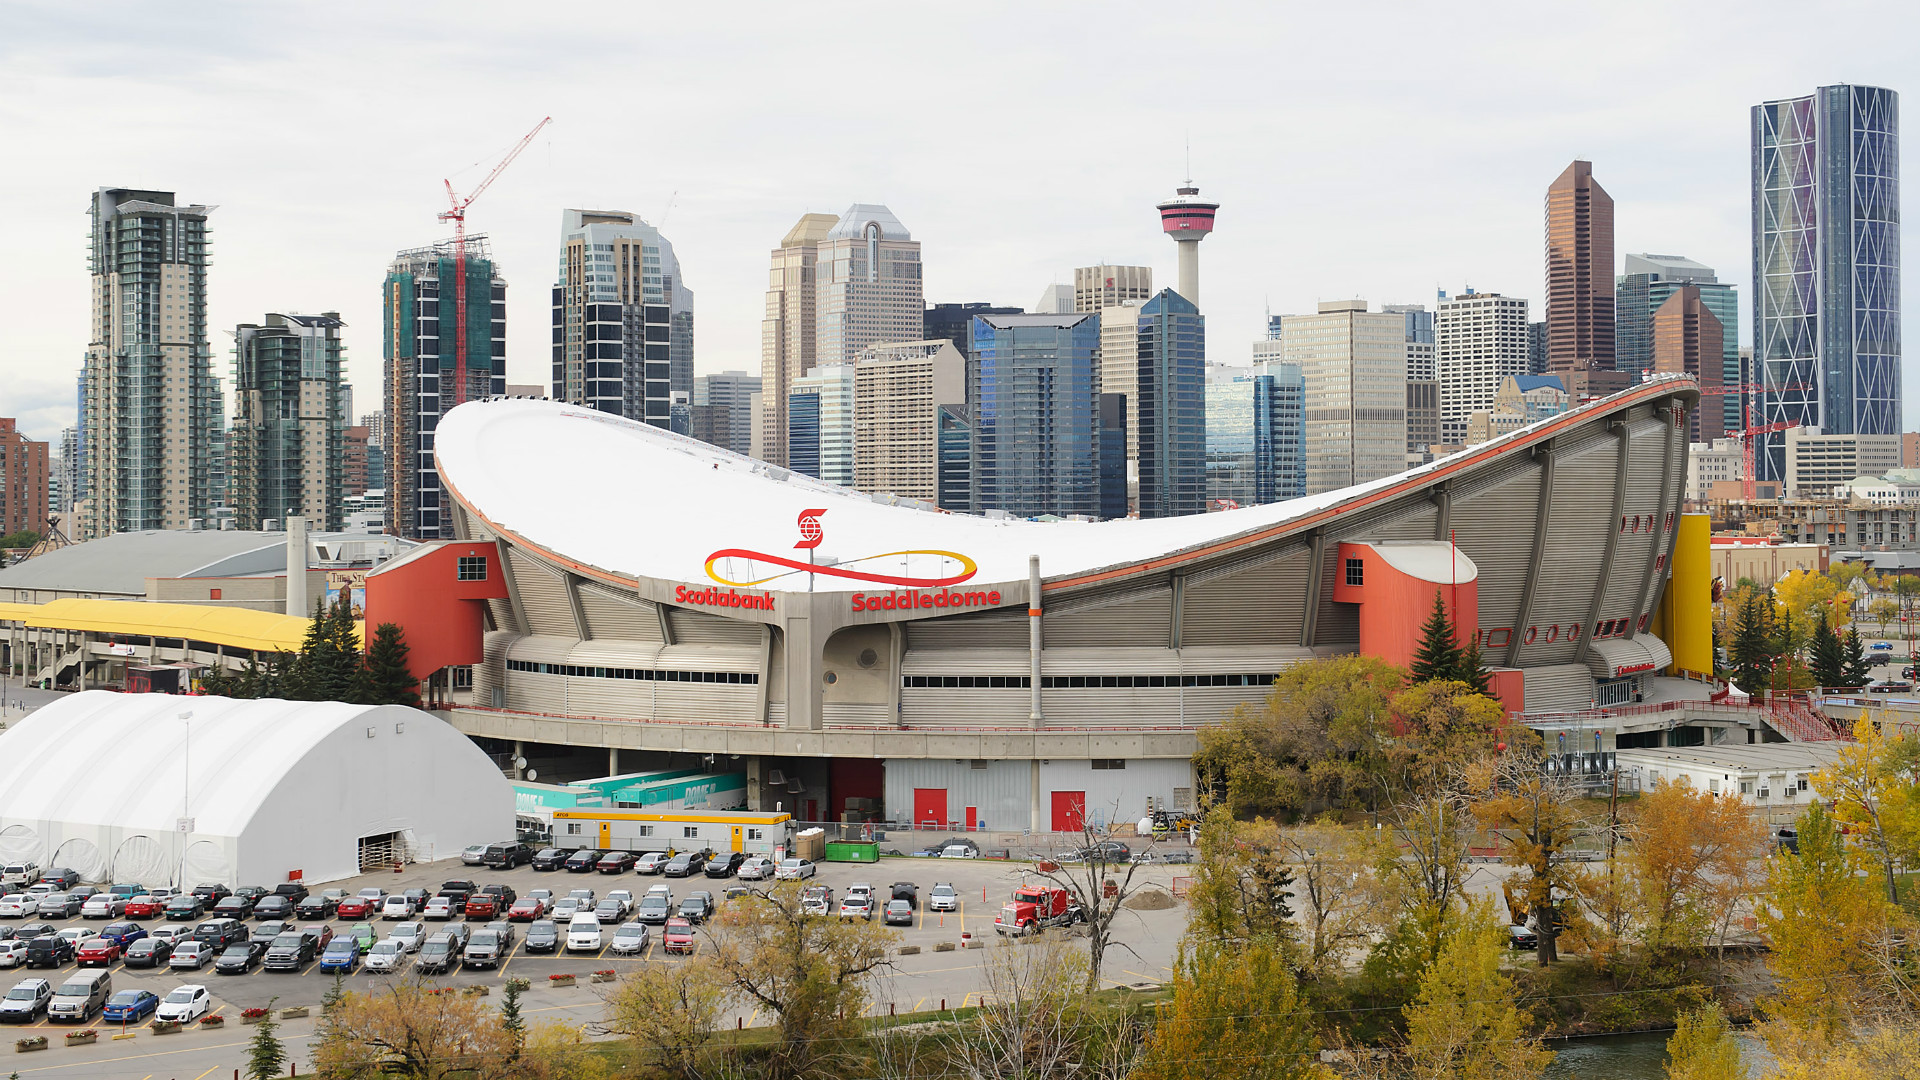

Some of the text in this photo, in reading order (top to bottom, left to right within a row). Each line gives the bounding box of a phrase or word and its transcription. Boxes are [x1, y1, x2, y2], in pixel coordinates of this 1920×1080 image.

[675, 585, 775, 611] Scotiabank
[851, 588, 1001, 612] Saddledome
[684, 784, 709, 806] DOME
